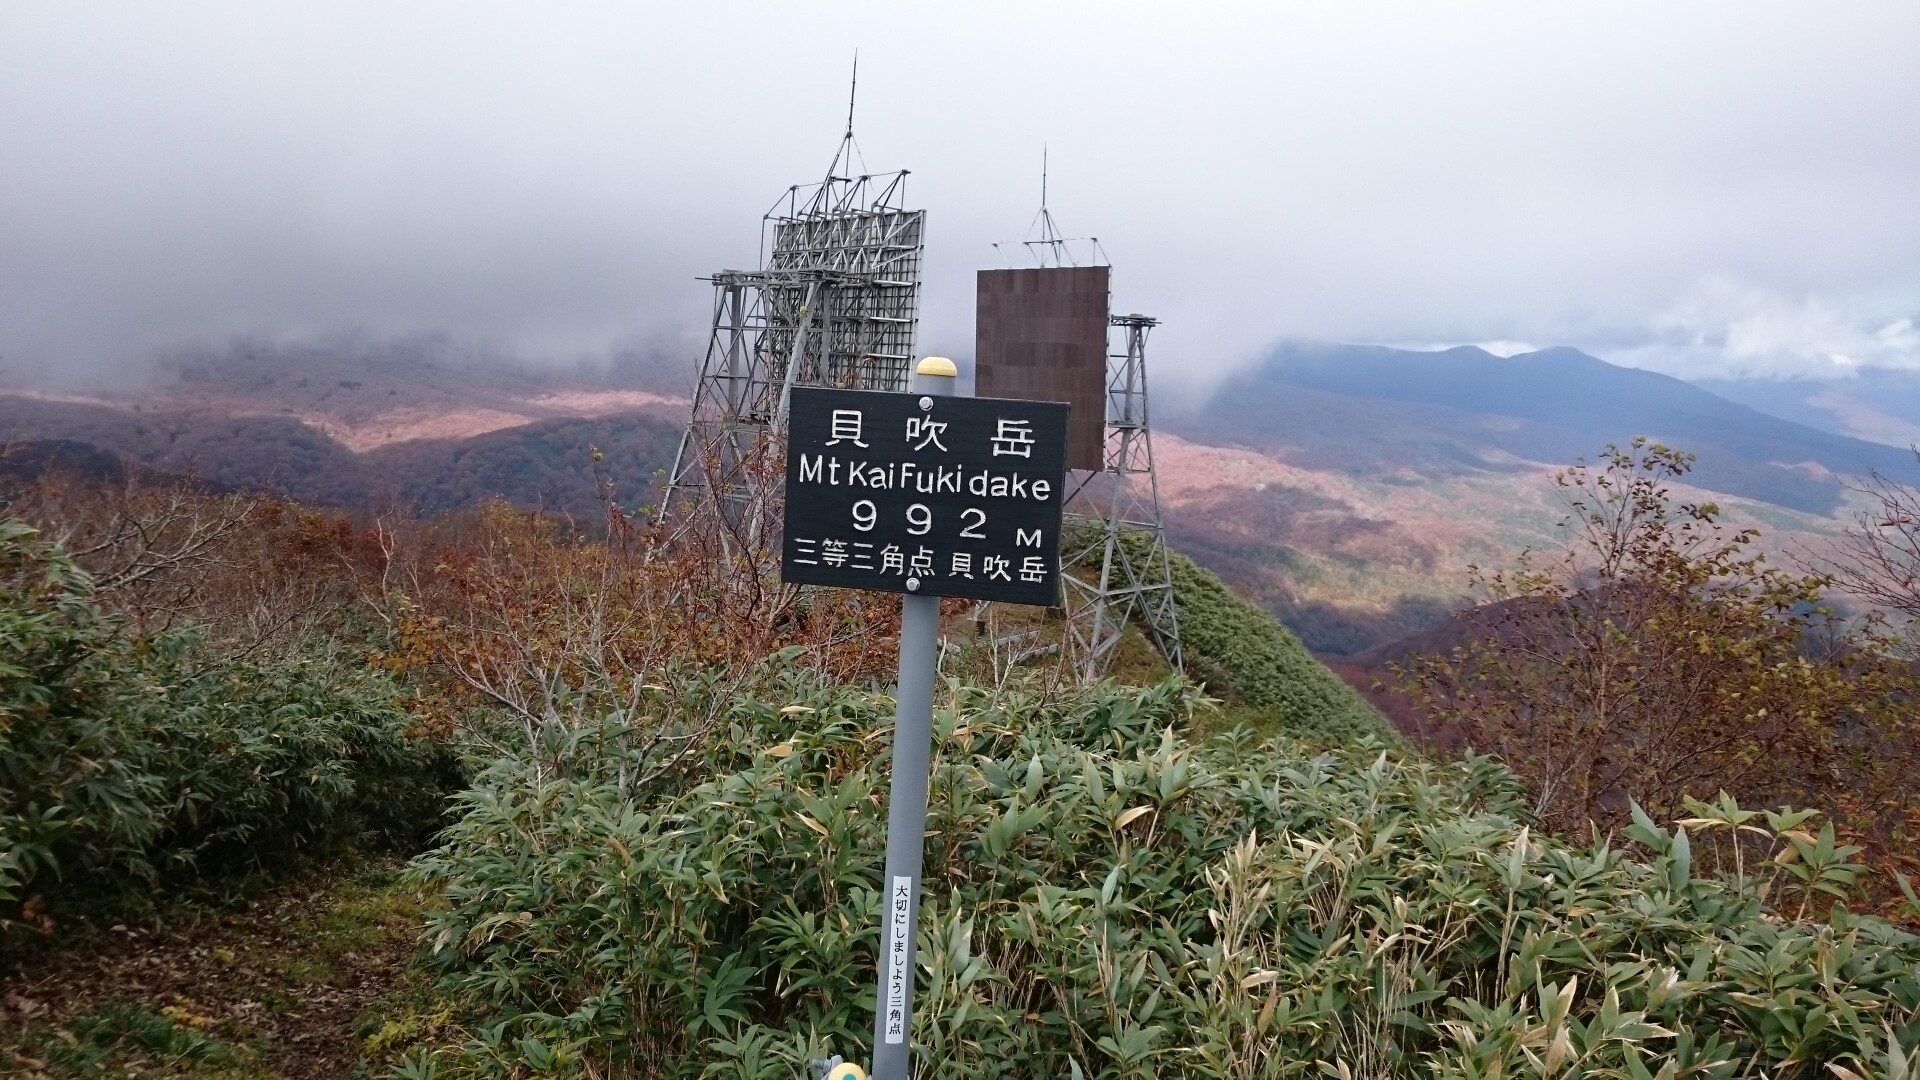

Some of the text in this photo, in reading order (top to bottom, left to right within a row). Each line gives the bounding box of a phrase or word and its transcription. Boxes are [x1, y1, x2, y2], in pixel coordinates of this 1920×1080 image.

[825, 409, 1036, 458] 貝吹岳
[799, 453, 841, 486] Mt
[852, 500, 1042, 548] 992 M
[793, 537, 1048, 584] 三等三角点 貝吹岳
